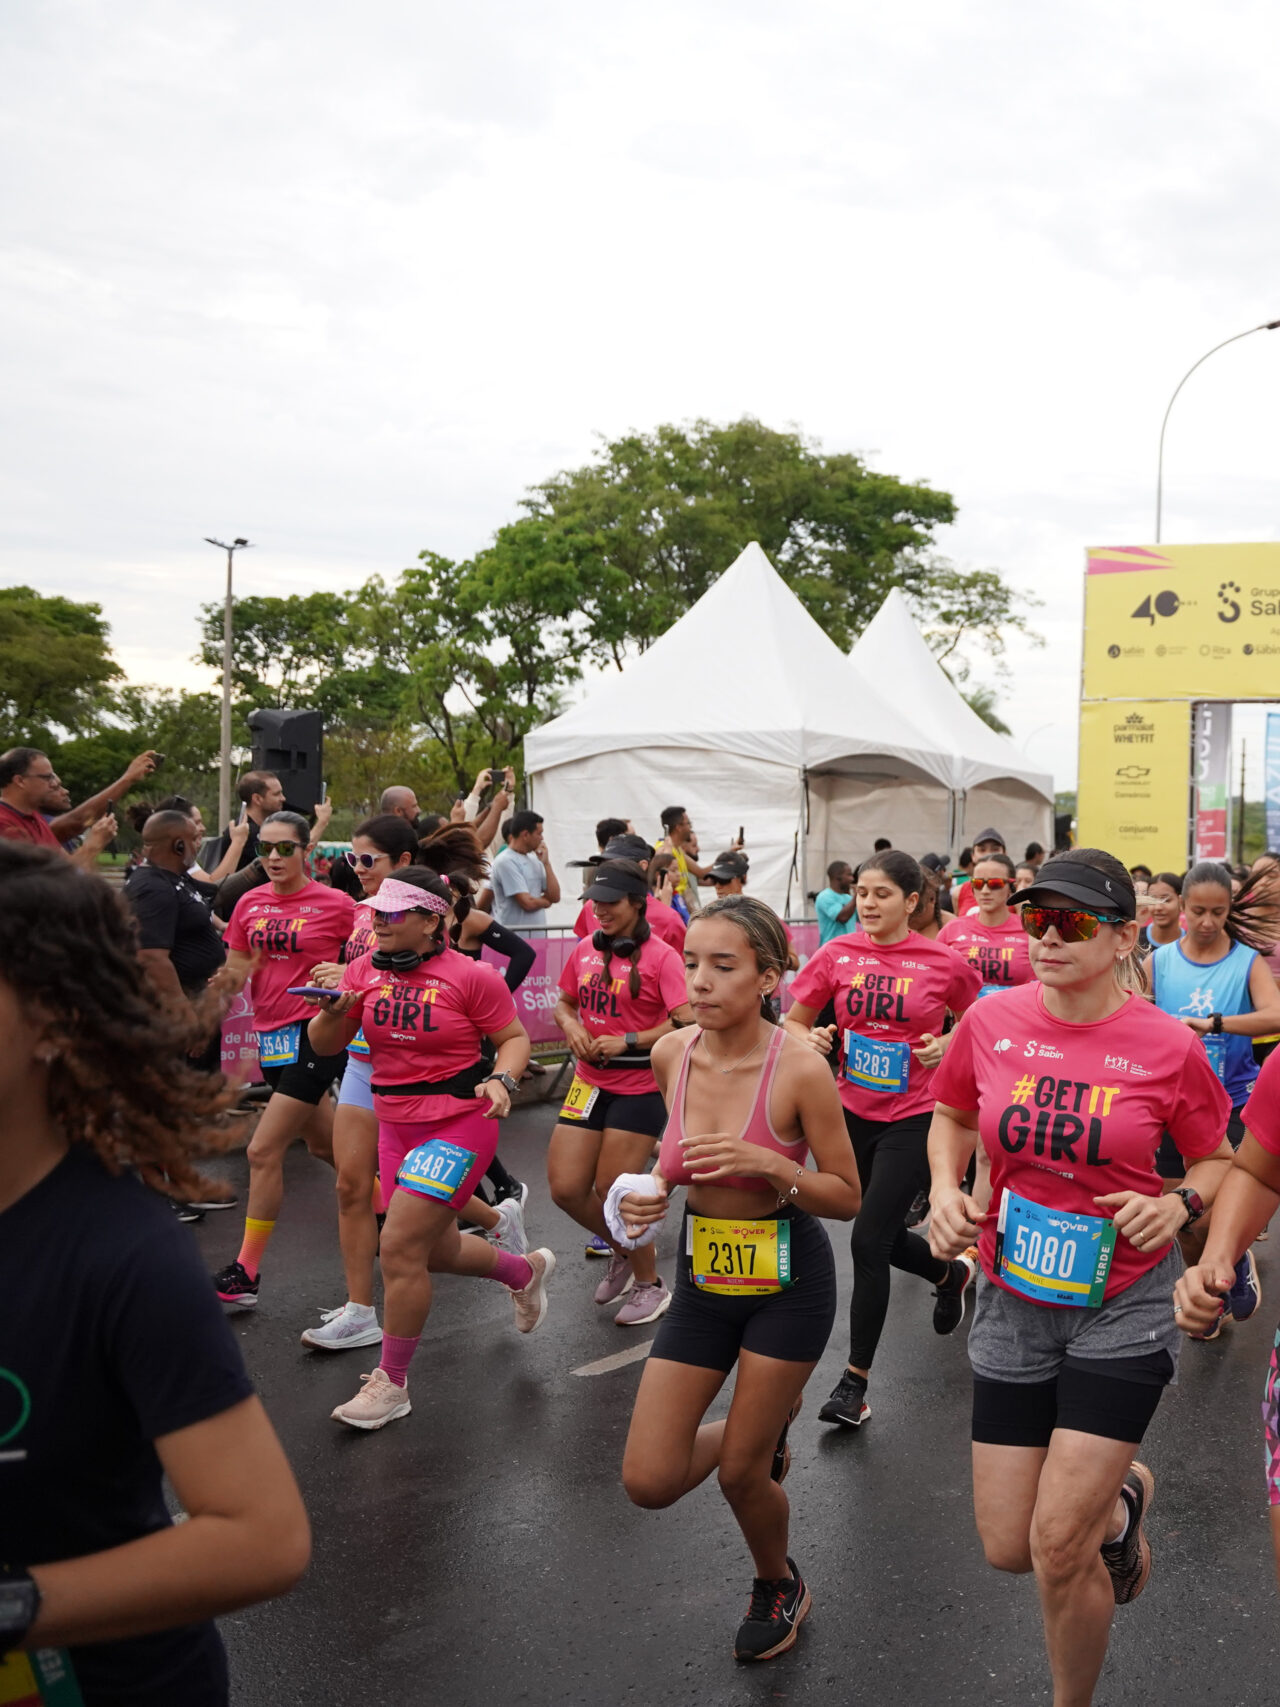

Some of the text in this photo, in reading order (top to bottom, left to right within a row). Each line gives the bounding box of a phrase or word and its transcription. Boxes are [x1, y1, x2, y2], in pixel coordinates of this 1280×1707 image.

[250, 930, 305, 953] GIRL
[522, 986, 561, 1011] Sabi
[578, 985, 623, 1018] GIRL
[846, 988, 911, 1023] GIRL
[373, 998, 440, 1033] GIRL
[263, 1034, 291, 1055] 5546
[854, 1048, 891, 1078] 5283
[998, 1104, 1113, 1167] GIRL
[410, 1151, 456, 1182] 5487
[708, 1241, 788, 1278] 2317 VERDE
[1013, 1224, 1111, 1284] 5080 VERDE
